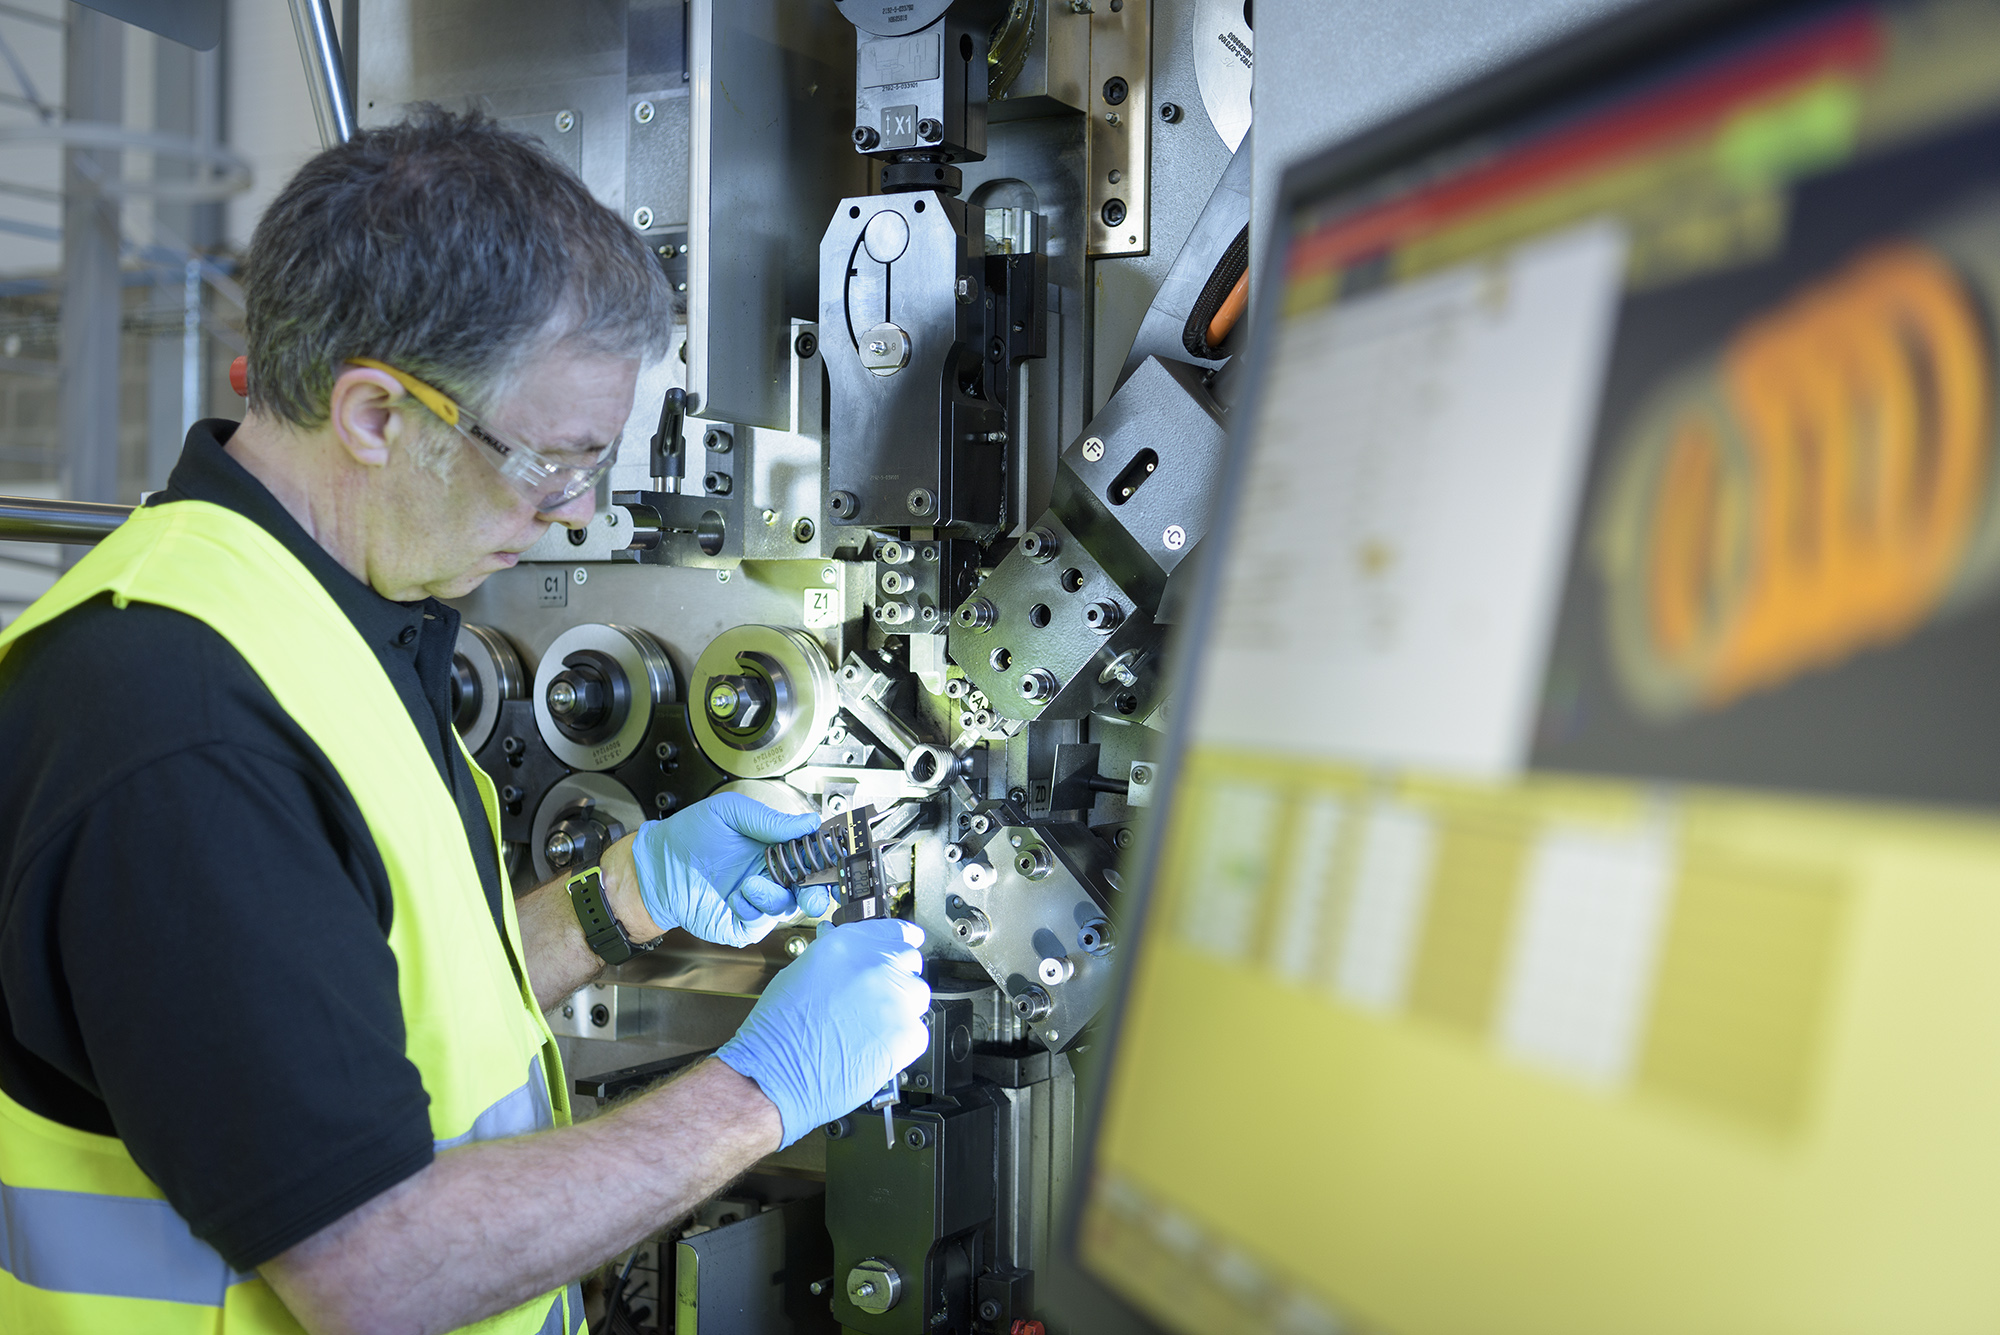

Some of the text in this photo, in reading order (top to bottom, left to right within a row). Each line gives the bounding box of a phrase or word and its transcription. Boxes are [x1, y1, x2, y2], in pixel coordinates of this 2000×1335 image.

[894, 115, 912, 135] X1
[891, 342, 897, 351] 8
[1087, 441, 1101, 453] F
[544, 576, 558, 593] C1
[814, 593, 828, 609] Z1
[972, 696, 984, 709] A
